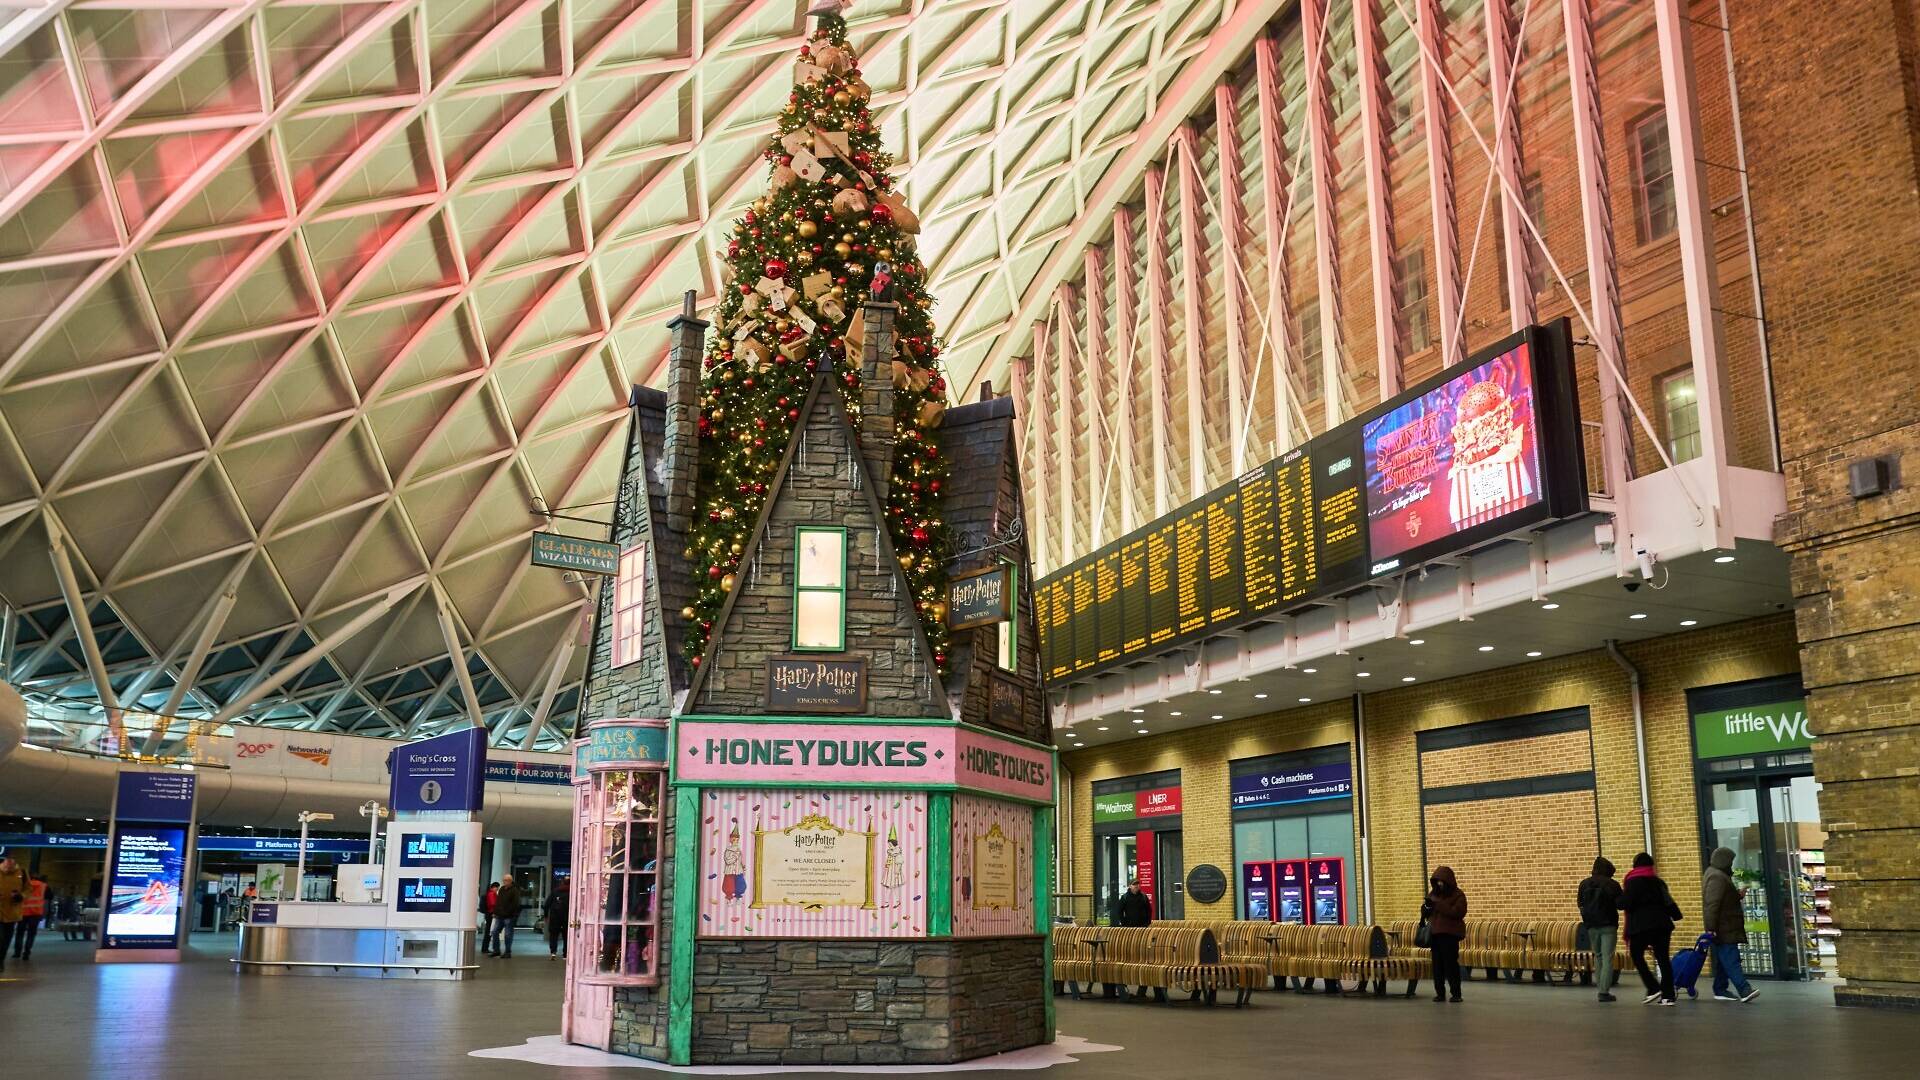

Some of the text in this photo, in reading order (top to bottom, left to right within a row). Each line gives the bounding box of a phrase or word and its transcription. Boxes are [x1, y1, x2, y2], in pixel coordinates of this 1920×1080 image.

[951, 577, 1001, 611] Harry Potter
[773, 663, 858, 692] Harry Potter
[1725, 712, 1765, 735] little
[237, 742, 266, 758] 200
[705, 738, 928, 767] HONEYDUKES
[409, 754, 457, 765] King's Cross
[966, 745, 1045, 786] HONEYDUKES
[489, 767, 508, 775] PART
[510, 768, 522, 777] OF
[522, 769, 539, 778] OUR
[540, 770, 554, 778] 200
[1271, 773, 1314, 785] Cash machines
[1308, 787, 1326, 795] Platforms
[1148, 793, 1167, 806] LNER
[1105, 802, 1133, 814] Waitrose
[265, 841, 292, 849] Platforms
[793, 833, 836, 848] Harry Potter
